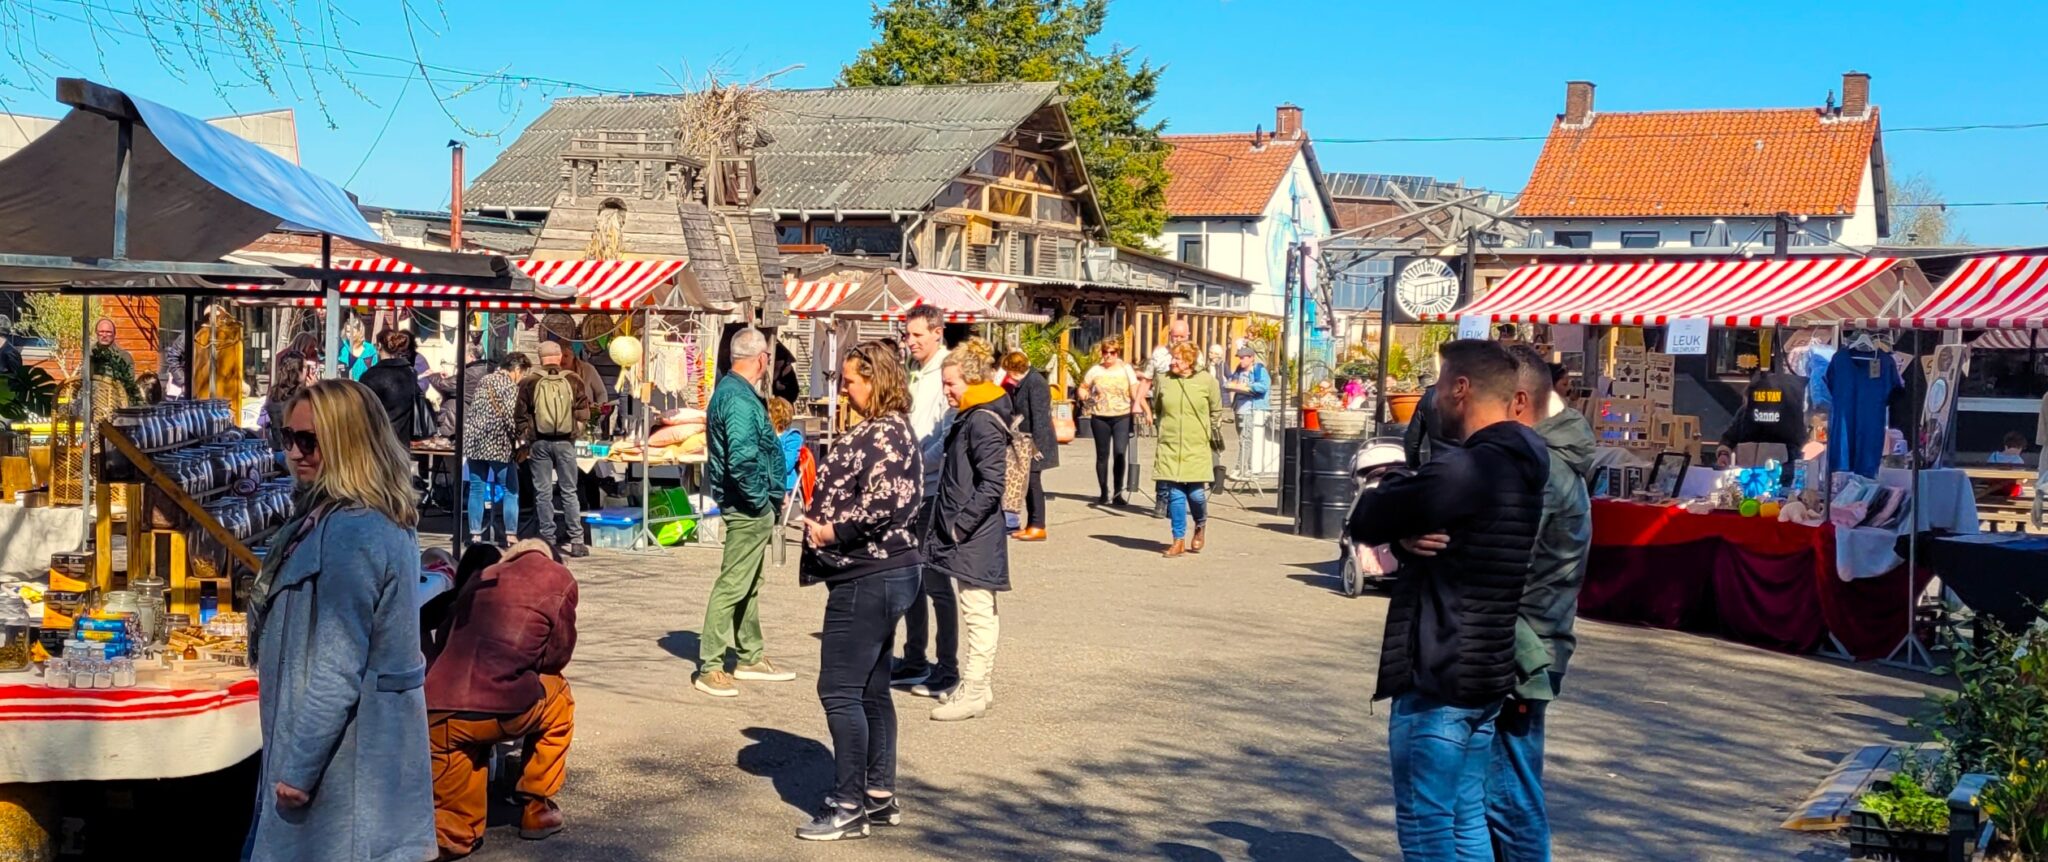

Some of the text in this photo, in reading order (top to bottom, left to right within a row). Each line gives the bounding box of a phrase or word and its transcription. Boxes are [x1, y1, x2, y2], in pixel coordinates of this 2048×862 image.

[1672, 335, 1701, 346] LEUK
[1754, 391, 1782, 401] TAS VAN
[1754, 408, 1780, 422] Sanne
